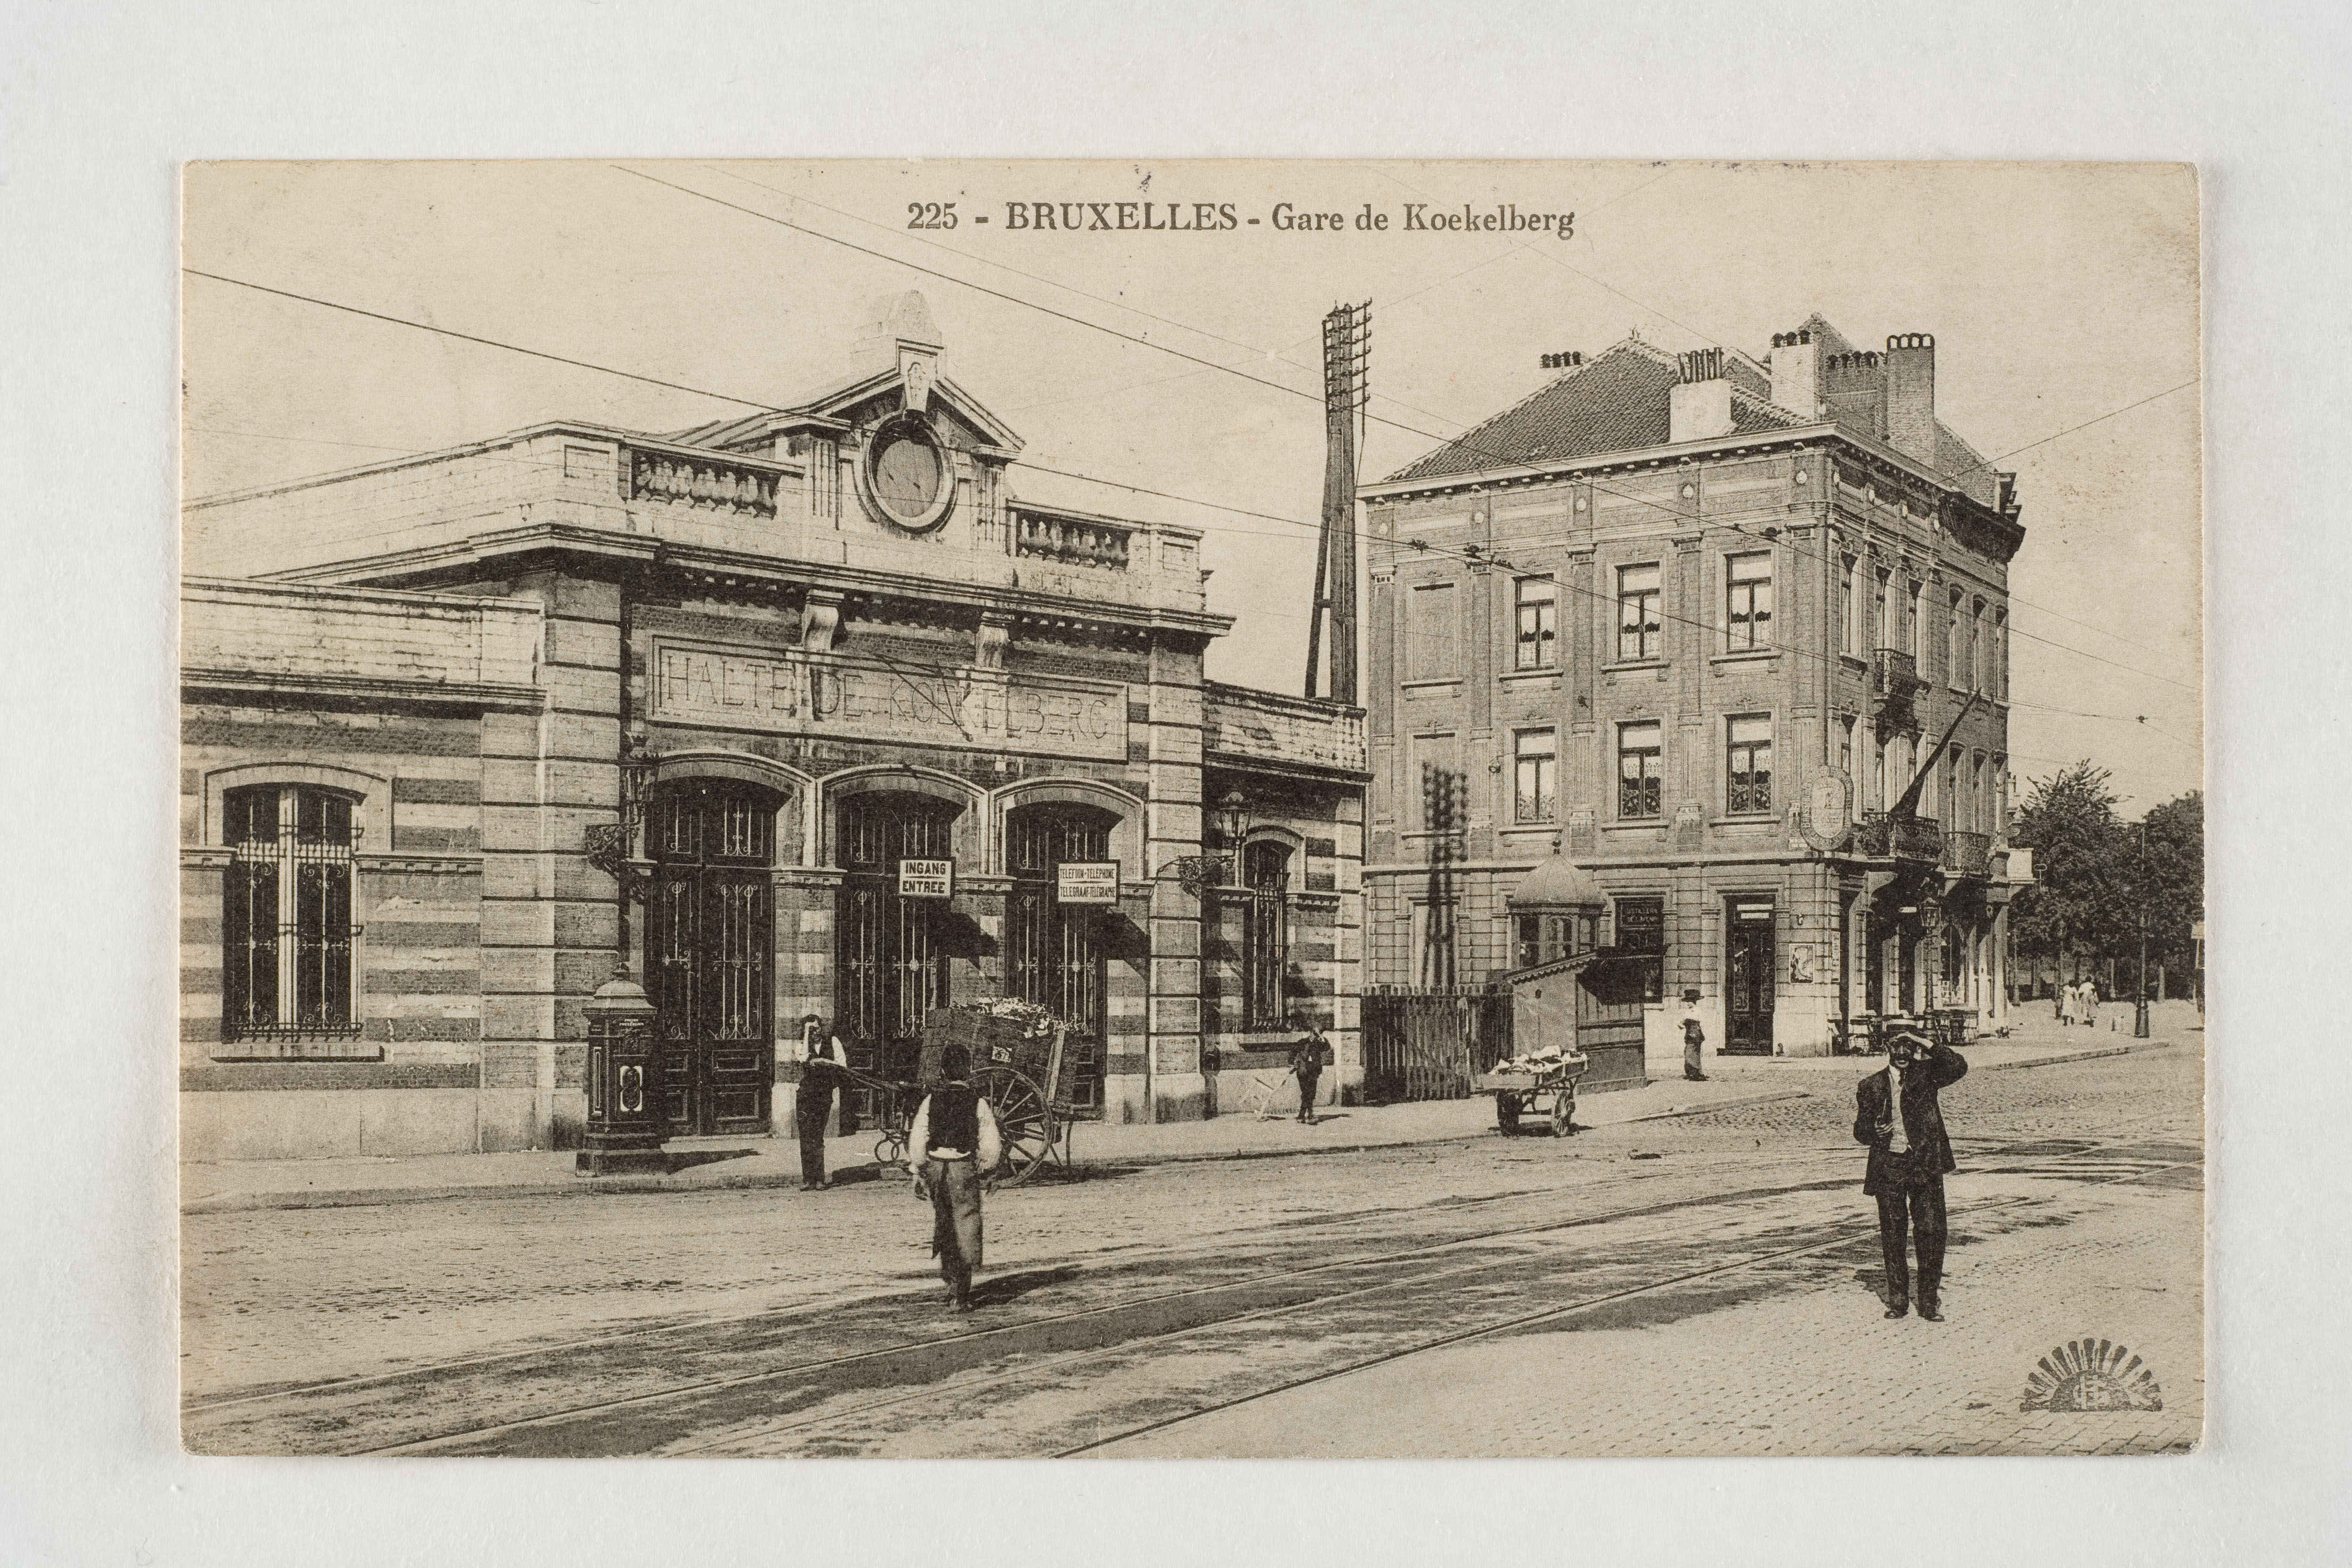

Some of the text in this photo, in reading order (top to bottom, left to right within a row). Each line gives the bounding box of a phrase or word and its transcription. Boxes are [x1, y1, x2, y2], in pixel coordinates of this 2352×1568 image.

[667, 655, 792, 710] HALTE
[906, 862, 946, 875] INGANG
[903, 880, 945, 894] ENTREE
